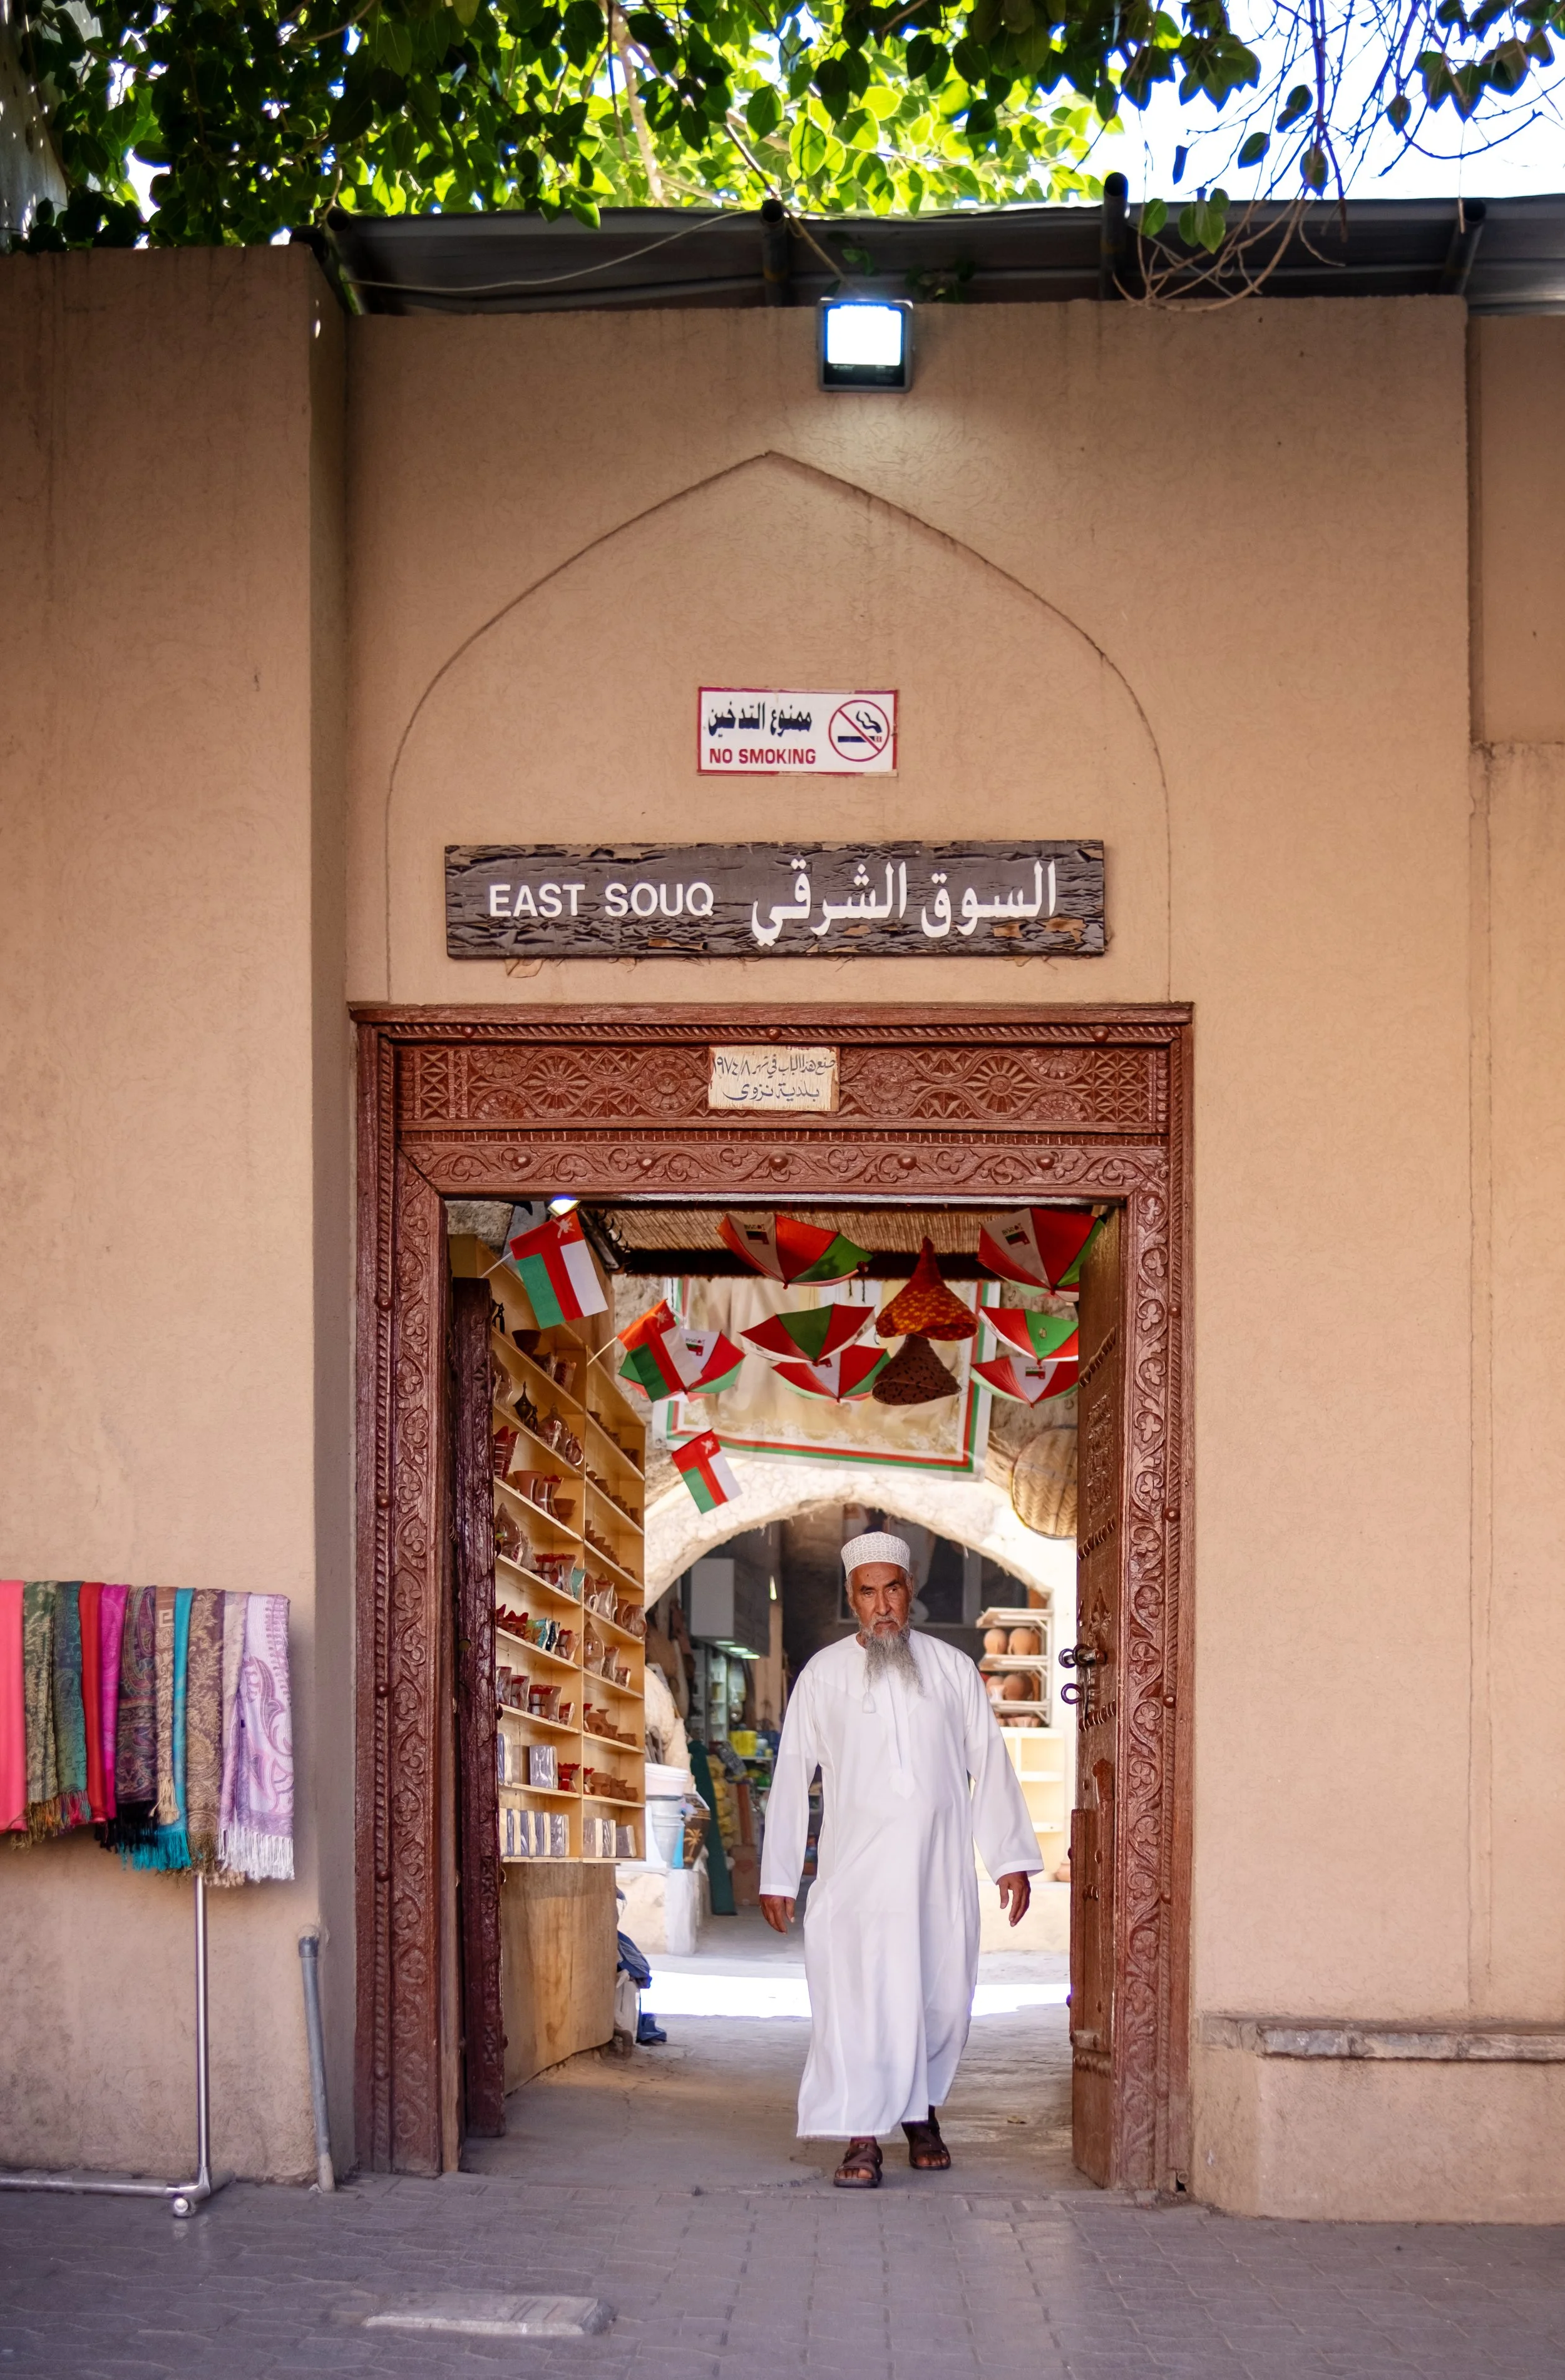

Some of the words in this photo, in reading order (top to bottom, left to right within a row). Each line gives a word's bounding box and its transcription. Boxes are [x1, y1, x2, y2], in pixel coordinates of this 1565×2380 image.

[708, 700, 766, 737] التدخين
[769, 705, 813, 737] ممنوع
[709, 748, 733, 764] NO
[738, 748, 816, 764] SMOKING
[489, 883, 586, 918] EAST
[604, 882, 714, 917] SOUQ
[751, 858, 908, 947] الشرقي
[921, 860, 1057, 938] السوق
[766, 1053, 777, 1079] في
[777, 1054, 801, 1076] الباب
[799, 1054, 816, 1073] هذا
[814, 1056, 836, 1076] صنع
[721, 1083, 774, 1102] نزوى
[775, 1080, 820, 1102] بلدية
